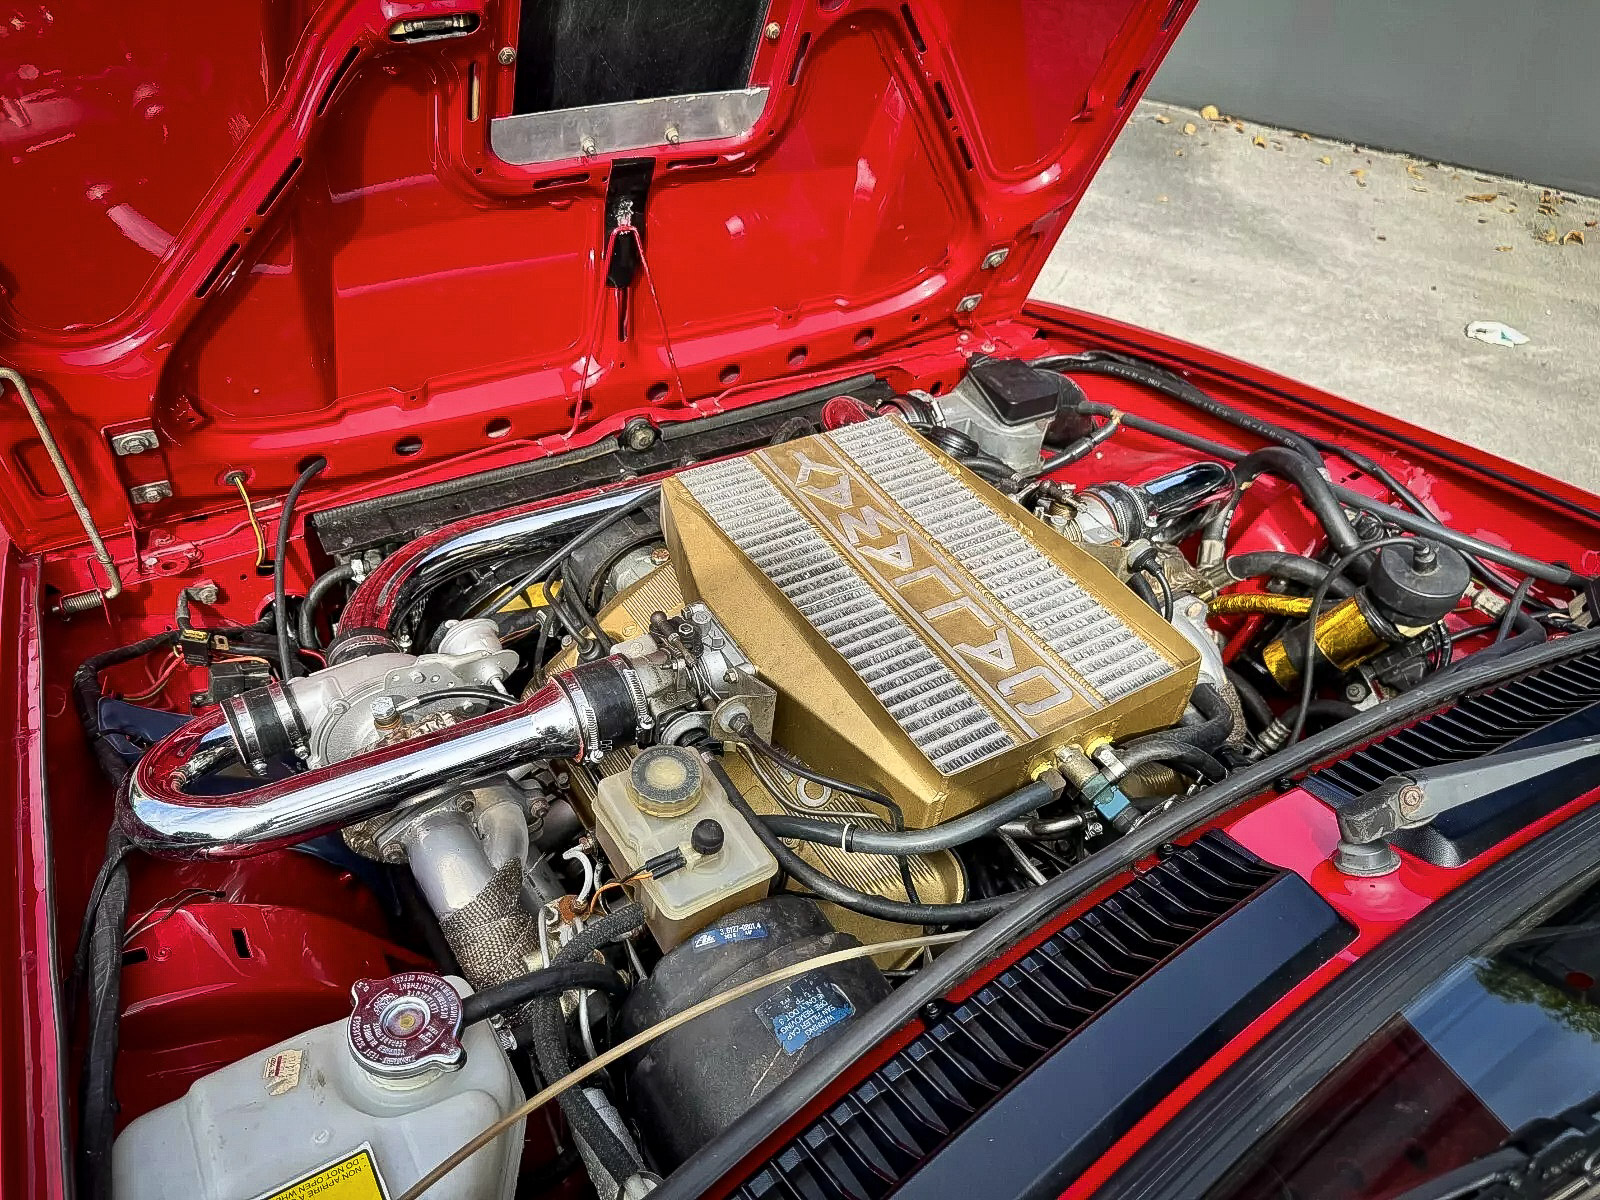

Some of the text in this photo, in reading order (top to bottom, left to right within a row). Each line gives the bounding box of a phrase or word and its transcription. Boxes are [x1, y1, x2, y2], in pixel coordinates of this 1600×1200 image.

[791, 451, 1073, 716] CALLAWAY
[780, 1009, 814, 1034] REMOVING
[785, 1007, 801, 1022] DOT
[804, 1014, 836, 1036] WARNING
[787, 1027, 801, 1041] CAP
[346, 1158, 359, 1170] DO
[326, 1167, 345, 1180] NOT
[342, 1167, 362, 1180] NON
[298, 1177, 324, 1191] OPEN
[308, 1178, 341, 1198] APRIRE
